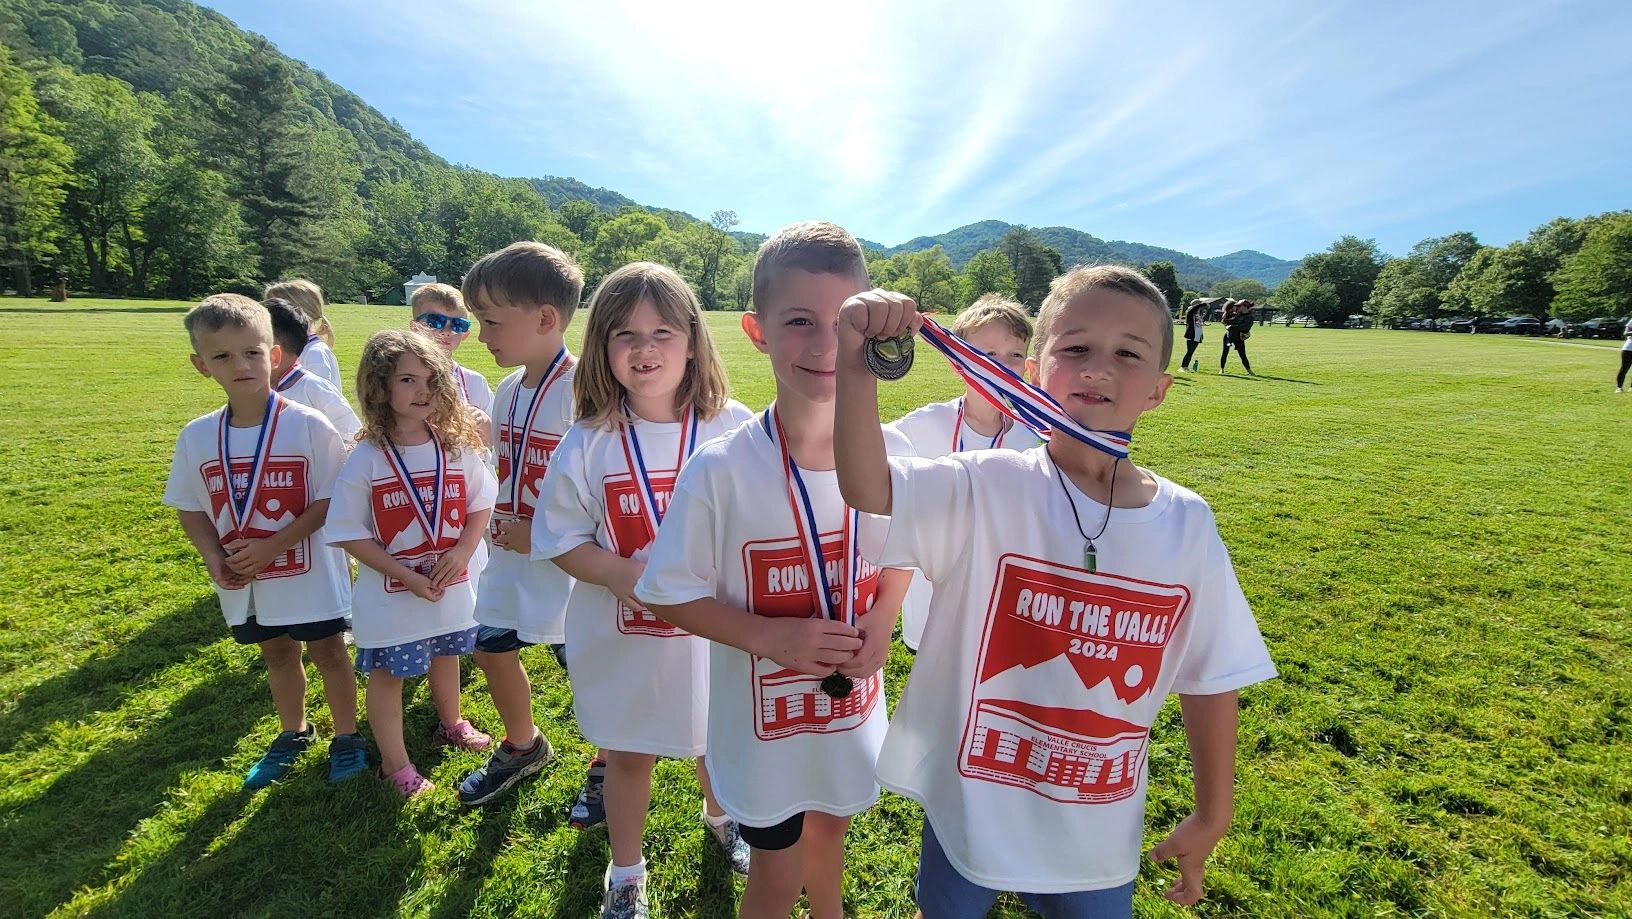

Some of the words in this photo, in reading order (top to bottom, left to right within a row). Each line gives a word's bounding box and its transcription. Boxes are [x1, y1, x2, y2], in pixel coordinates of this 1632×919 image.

[231, 473, 249, 489] HE
[262, 471, 294, 488] ALLE
[417, 485, 435, 502] HE
[619, 493, 640, 515] RU
[768, 564, 809, 593] RUN
[1016, 588, 1065, 626] RUN
[1069, 600, 1112, 637] THE
[1114, 610, 1169, 644] VALLE
[1068, 638, 1119, 662] 2024
[1031, 736, 1078, 755] ELEMENTARY
[1080, 750, 1107, 759] SCHOOL
[1047, 735, 1070, 747] VALLE
[1071, 742, 1097, 752] CRUCIS
